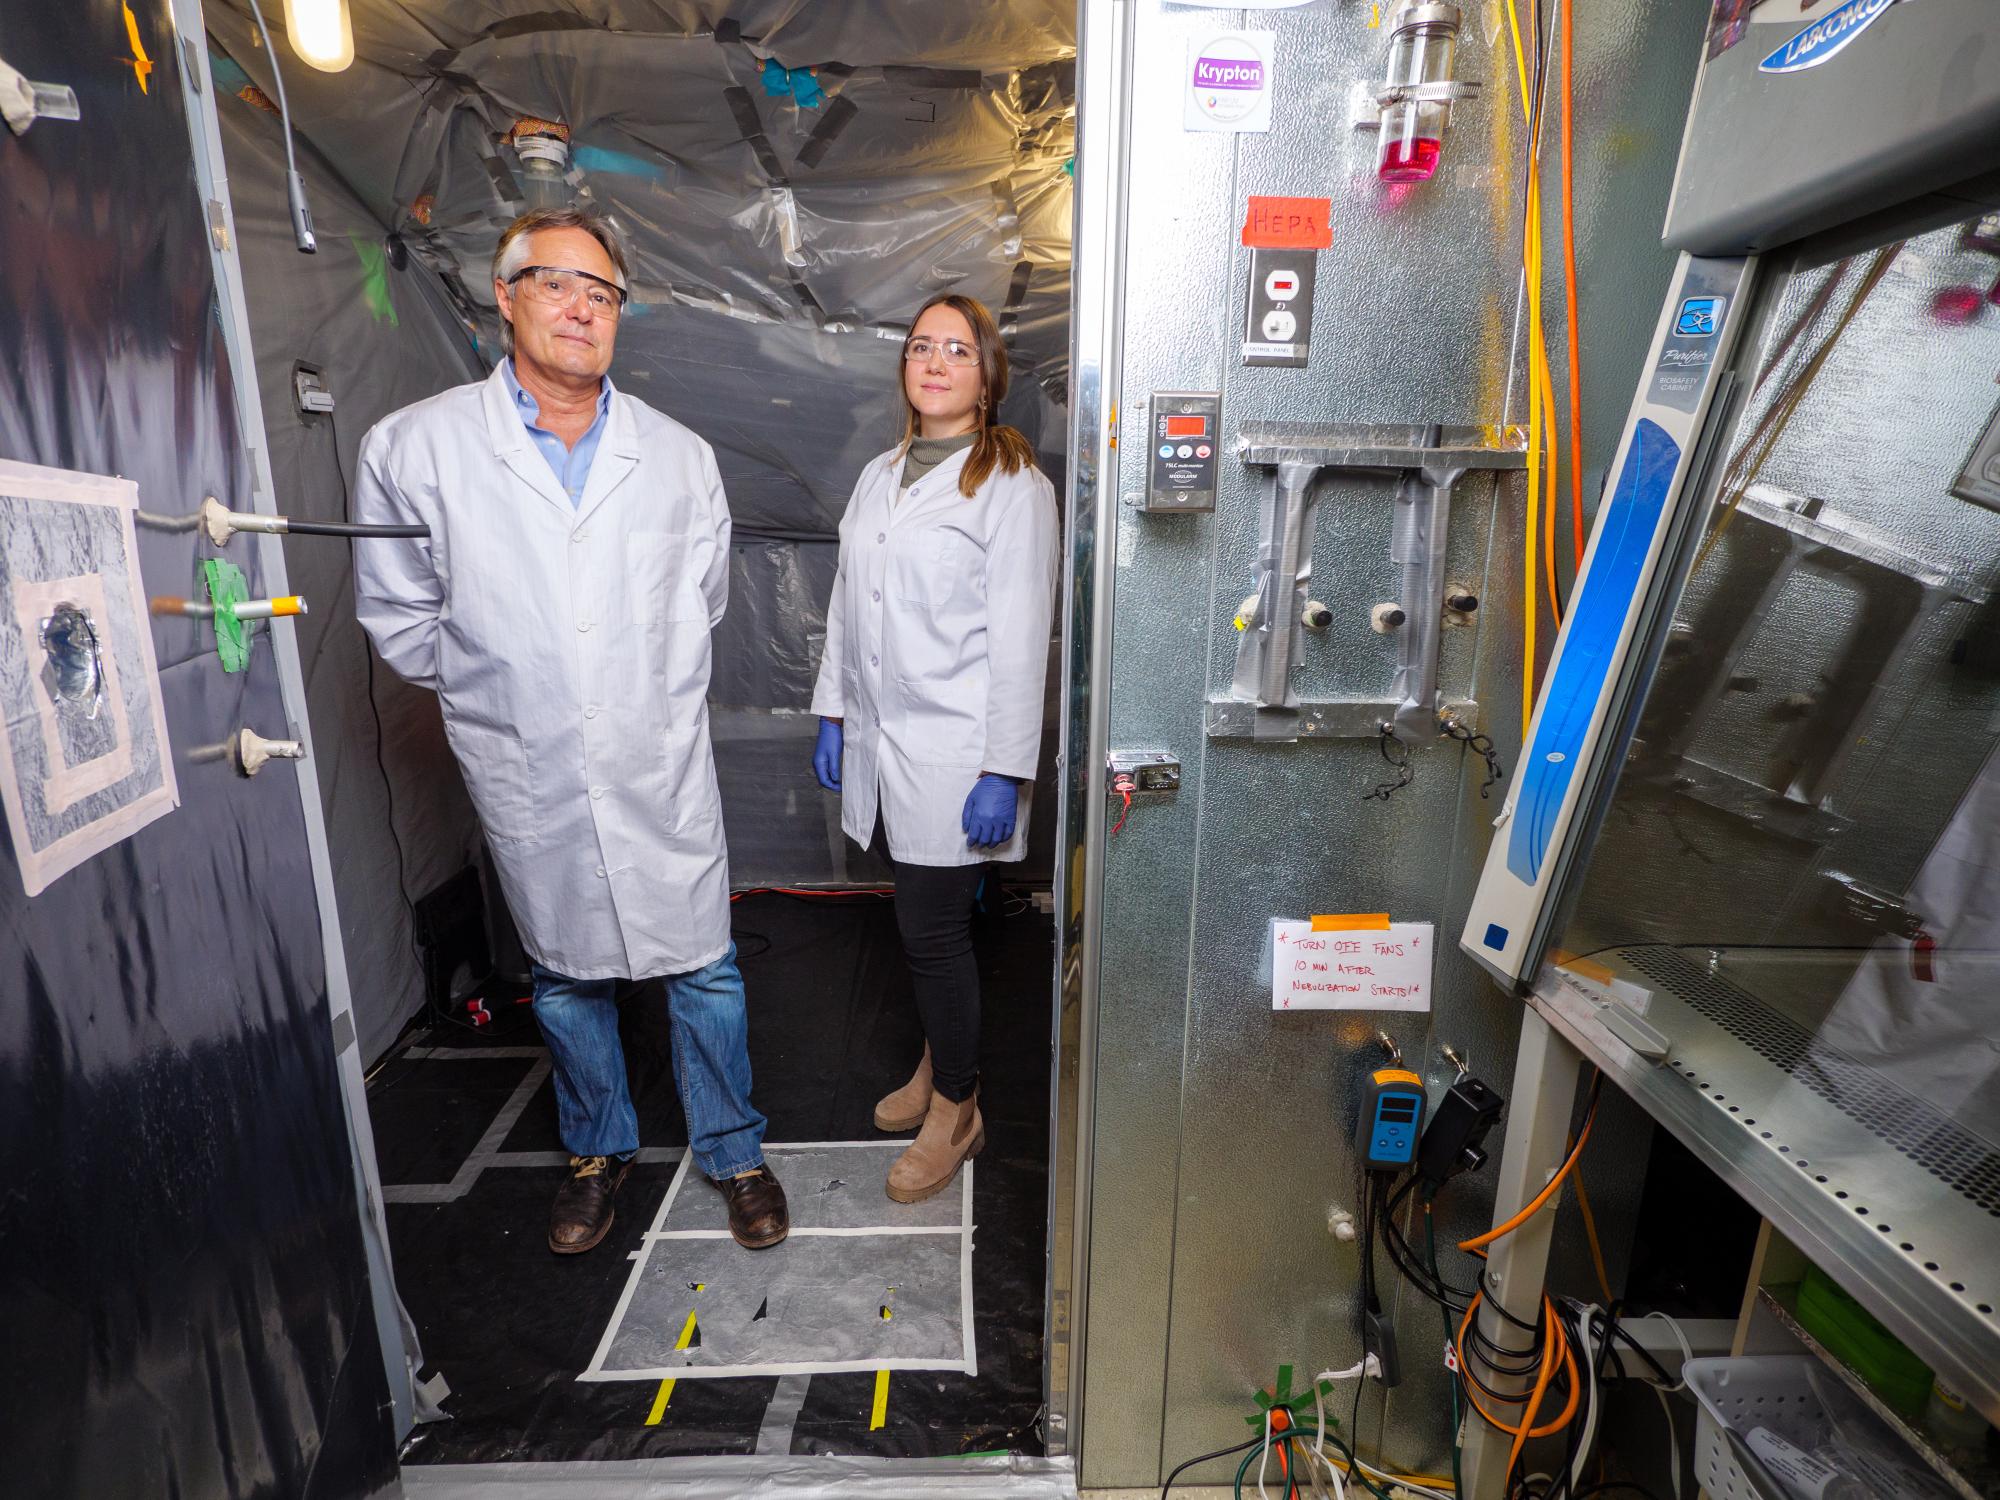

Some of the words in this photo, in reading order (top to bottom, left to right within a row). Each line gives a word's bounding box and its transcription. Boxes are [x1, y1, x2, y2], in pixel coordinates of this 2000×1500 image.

[1198, 63, 1260, 82] Krypton
[1254, 208, 1316, 233] HEPA
[1663, 350, 1708, 363] Purifier
[1659, 377, 1699, 385] BIOSAFETY
[1293, 939, 1326, 951] TURN
[1334, 941, 1361, 953] OFF
[1372, 942, 1404, 957] FANS
[1294, 960, 1307, 971] 10
[1312, 962, 1328, 971] MIN
[1338, 964, 1375, 975] AFTER
[1292, 980, 1361, 992] NEBULIZATION
[1371, 984, 1412, 1001] STARTS!
